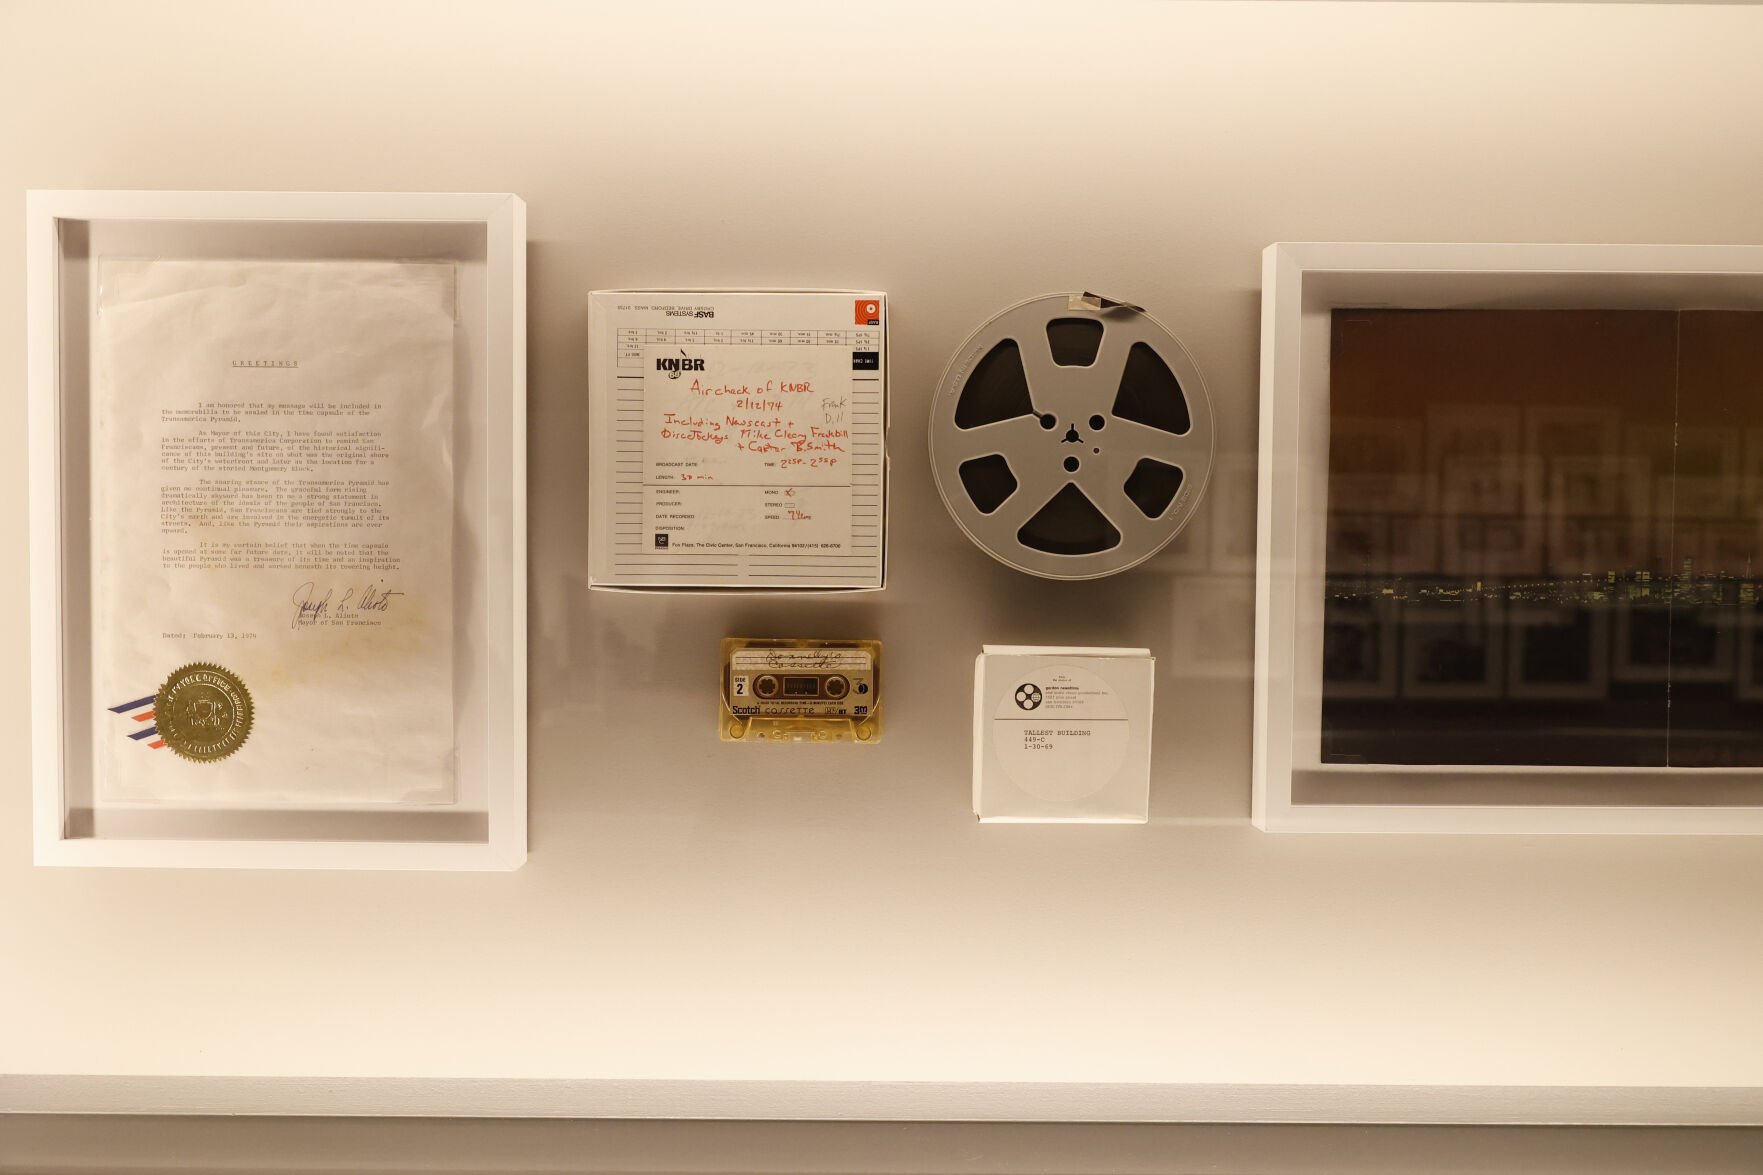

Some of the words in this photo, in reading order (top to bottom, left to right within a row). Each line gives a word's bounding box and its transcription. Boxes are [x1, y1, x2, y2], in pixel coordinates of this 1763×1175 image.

[656, 358, 705, 371] KNBR
[757, 378, 772, 394] of
[780, 382, 814, 393] KNBR
[736, 399, 783, 410] 2/12/74
[664, 413, 720, 431] Including
[726, 416, 781, 428] Newscast
[736, 684, 743, 695] 2
[733, 705, 760, 714] Scotch
